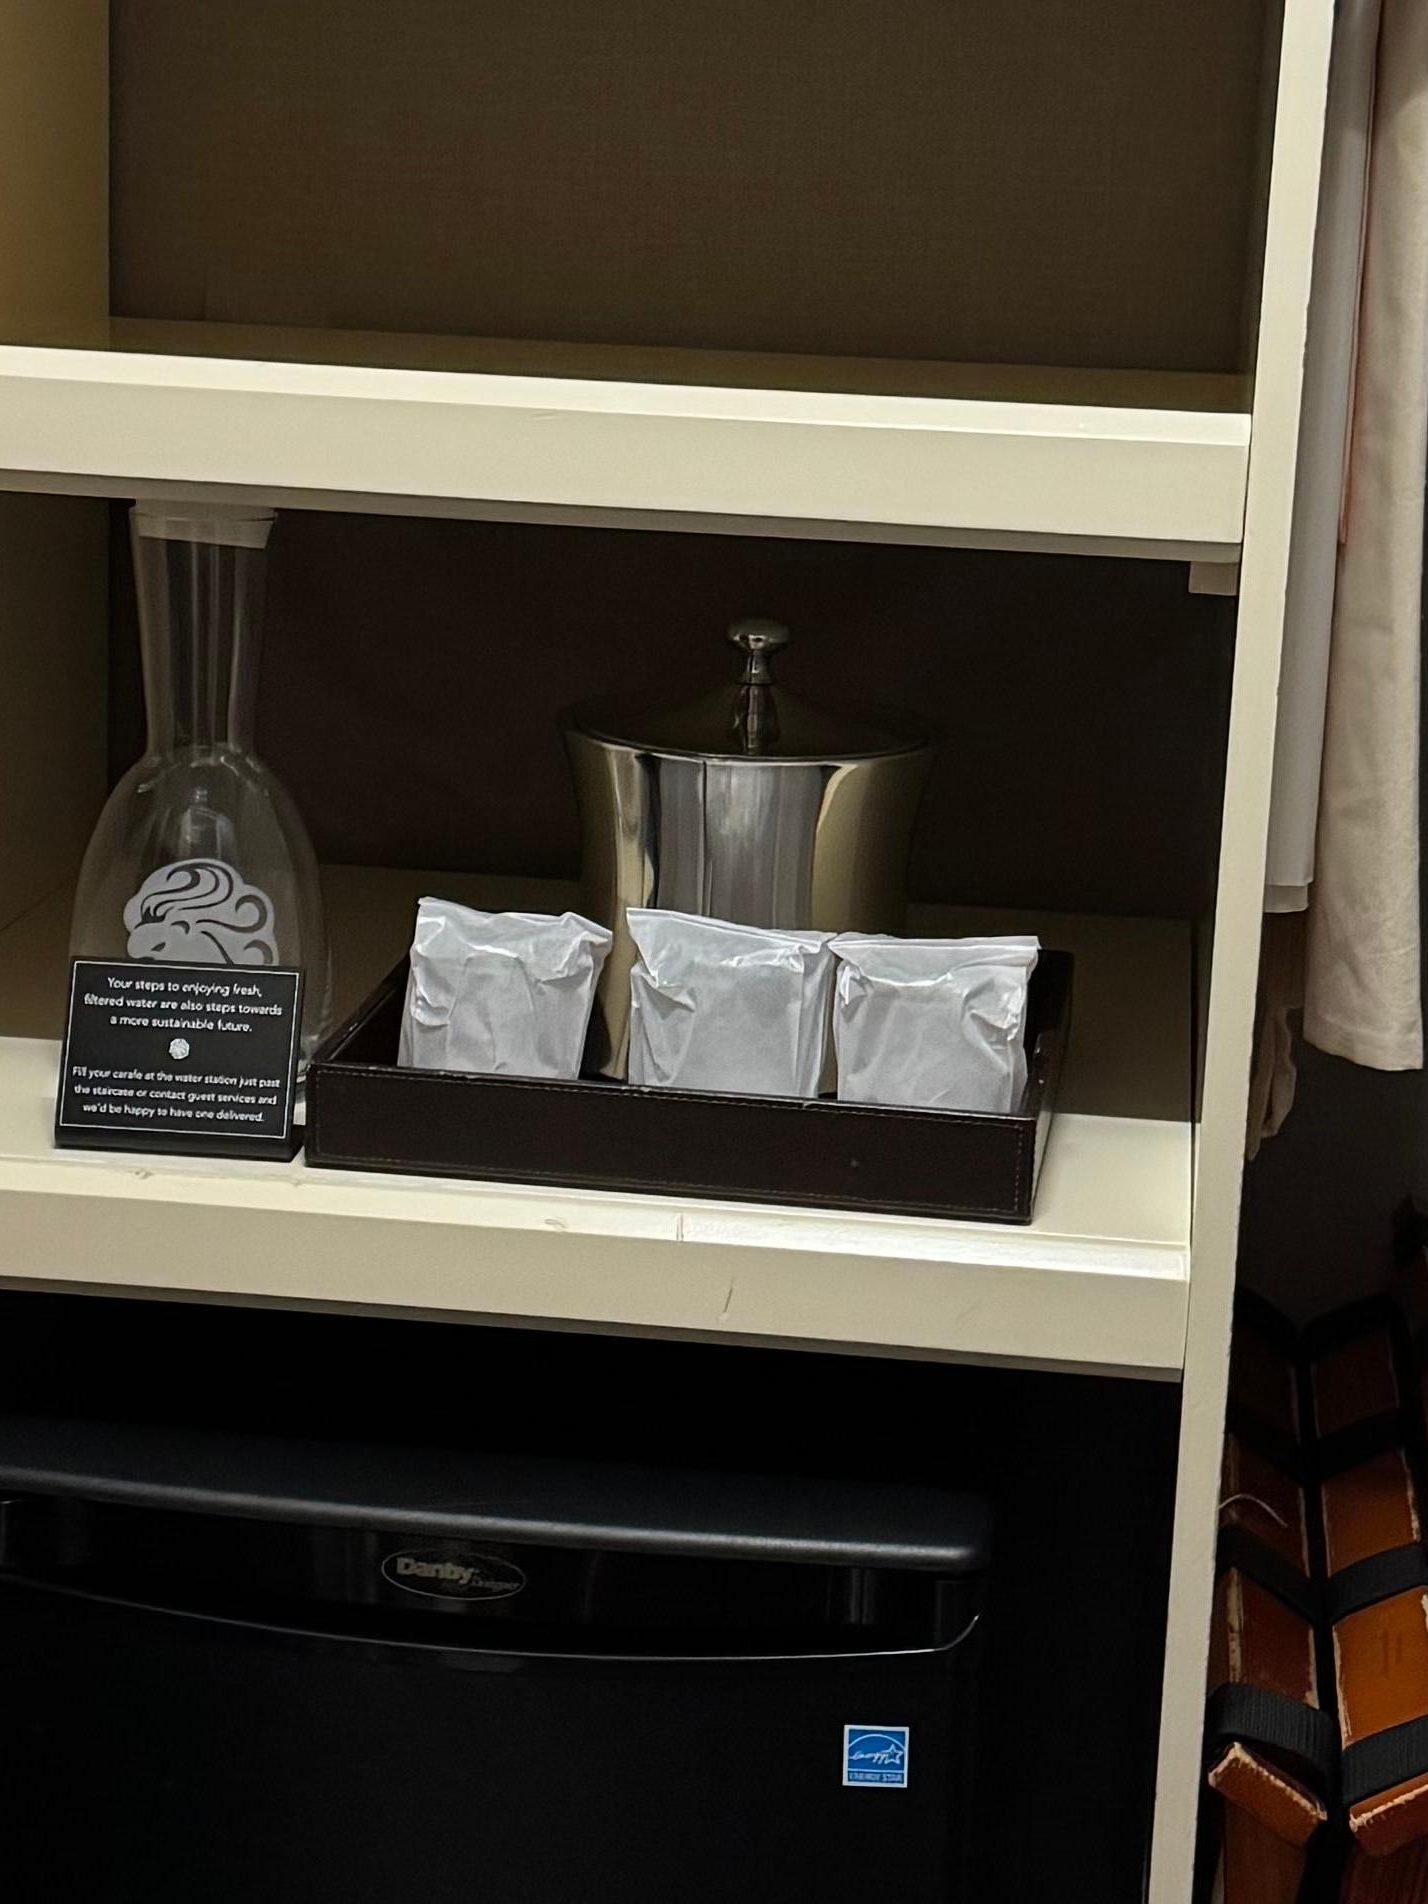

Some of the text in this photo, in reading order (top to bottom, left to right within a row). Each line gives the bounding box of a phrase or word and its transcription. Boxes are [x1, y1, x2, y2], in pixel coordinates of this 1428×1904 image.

[108, 977, 262, 997] Your steps to enjoying fresh,
[84, 993, 282, 1015] filtered water are also steps towards
[110, 1016, 252, 1032] a more sustainable future.
[73, 1066, 280, 1088] Fill your carafe at the water station just past
[74, 1084, 277, 1105] the staircase or contact guest services and
[109, 1104, 122, 1114] be
[124, 1105, 155, 1117] happy
[157, 1108, 168, 1116] to
[170, 1107, 192, 1118] have
[195, 1110, 214, 1119] one
[396, 1557, 477, 1584] Danby
